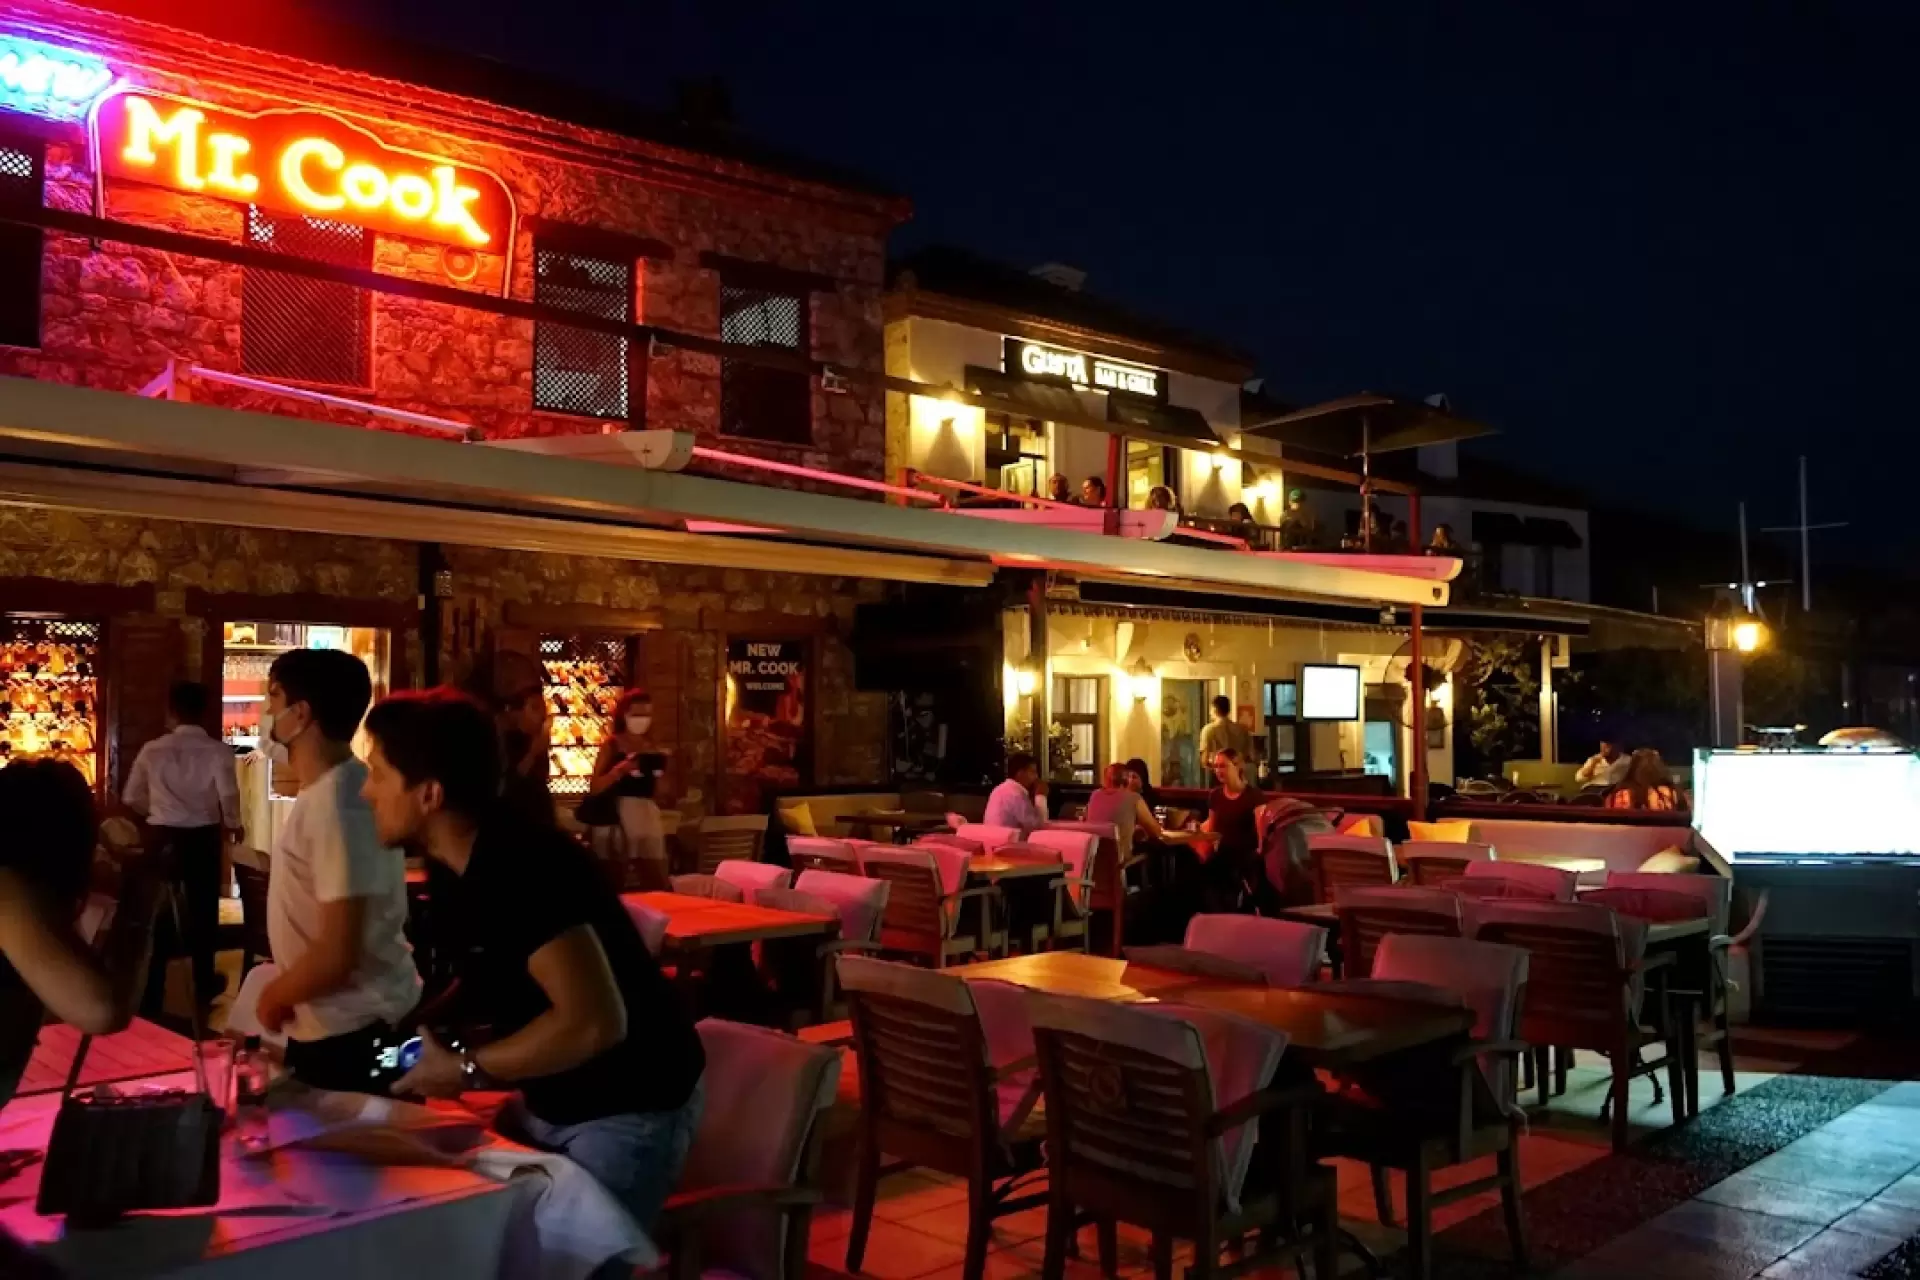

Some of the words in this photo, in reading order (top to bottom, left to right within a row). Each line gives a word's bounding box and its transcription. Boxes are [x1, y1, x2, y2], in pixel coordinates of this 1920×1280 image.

[280, 137, 491, 244] Cook
[747, 643, 781, 657] NEW
[730, 660, 757, 675] MR.
[758, 660, 798, 675] COOK
